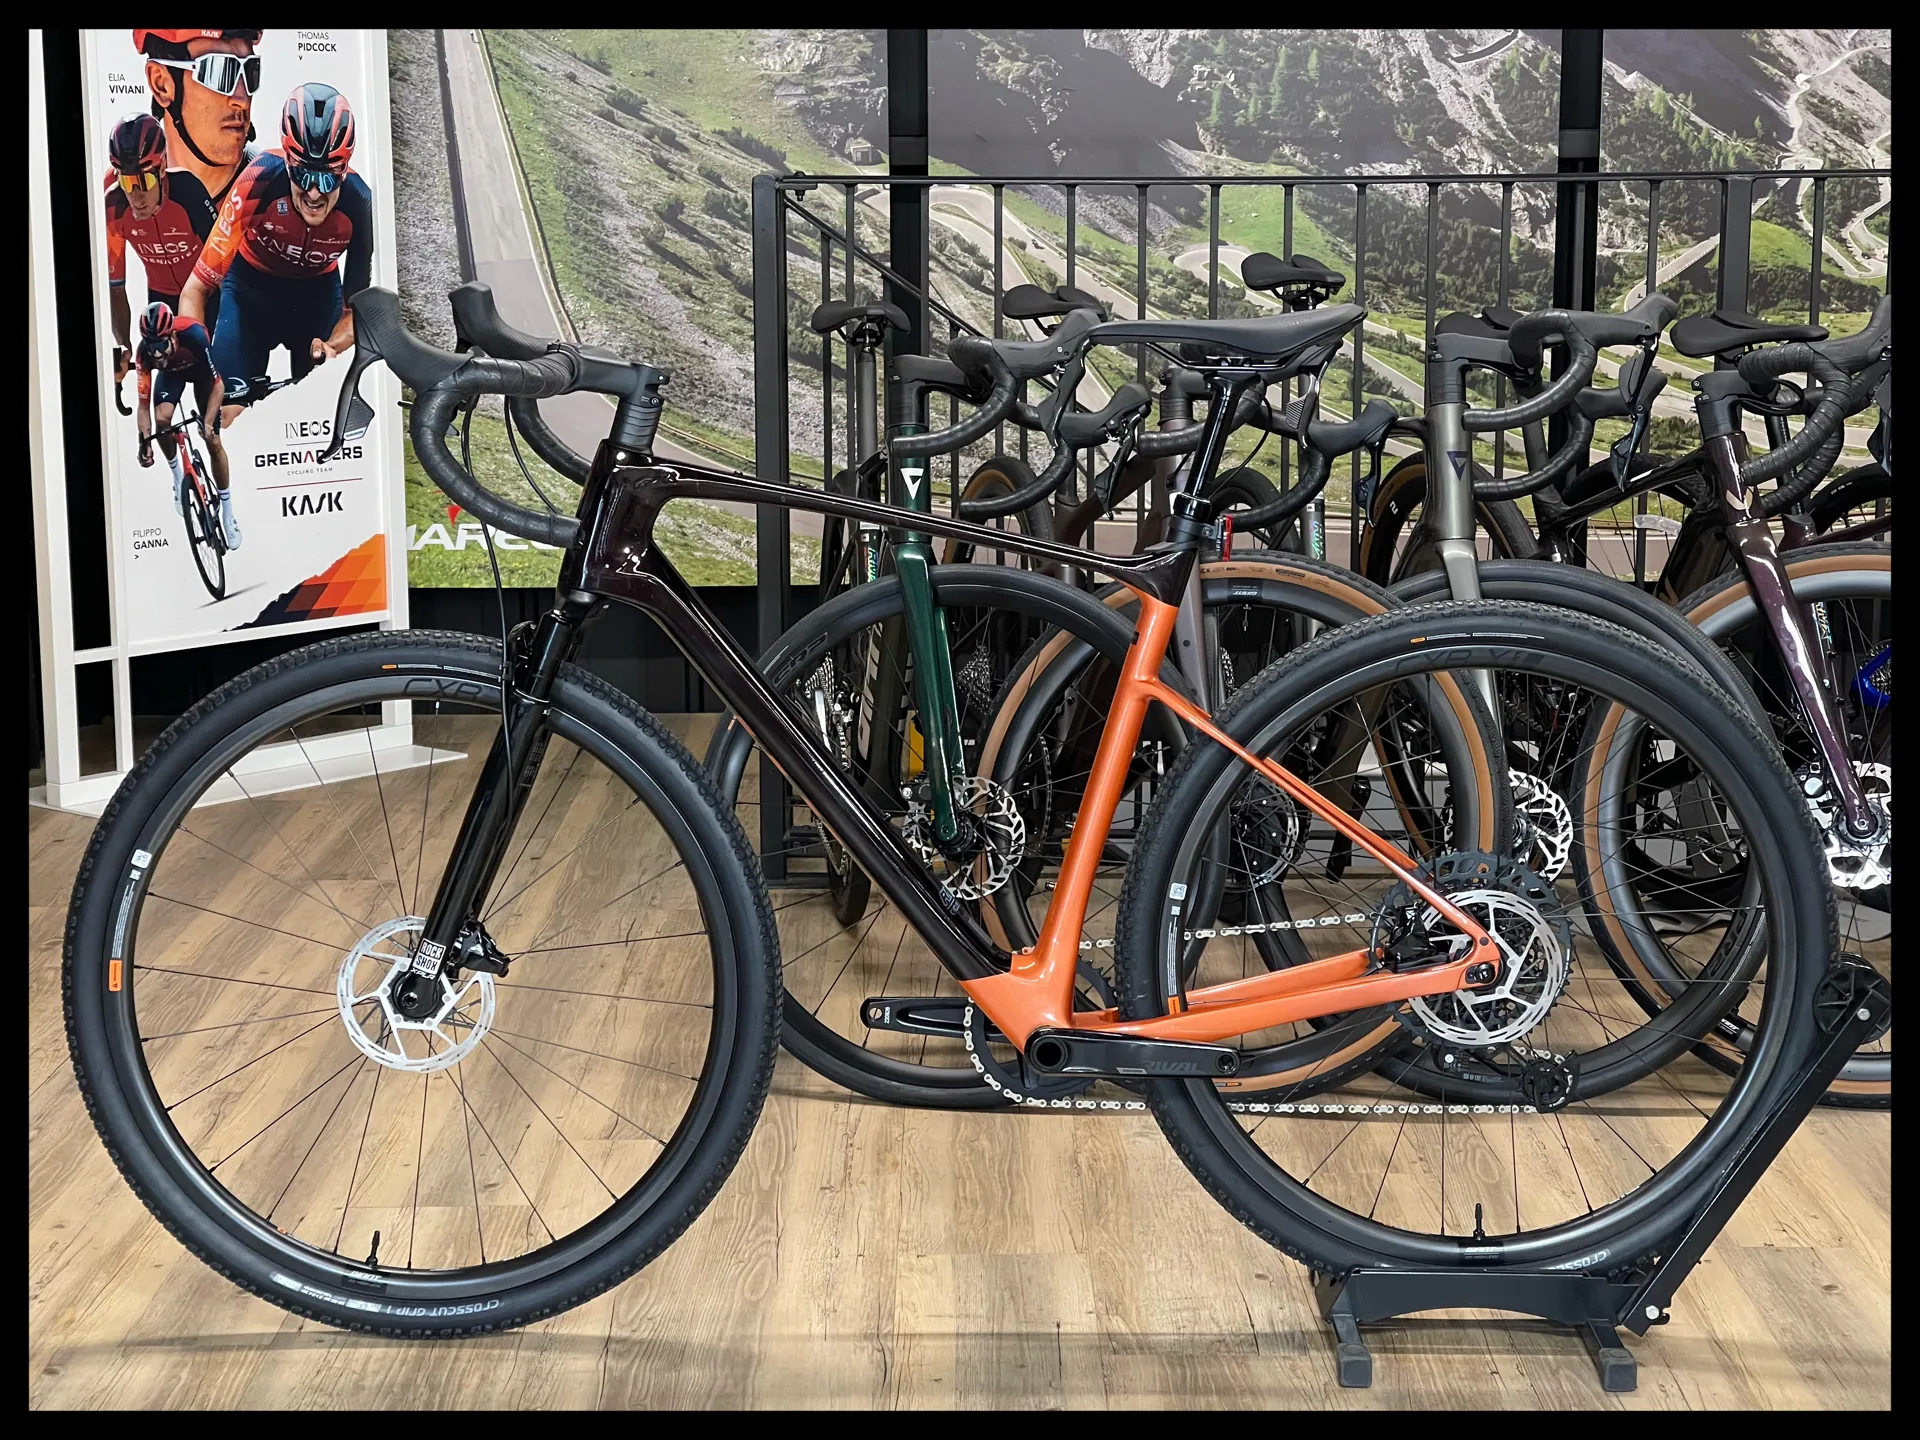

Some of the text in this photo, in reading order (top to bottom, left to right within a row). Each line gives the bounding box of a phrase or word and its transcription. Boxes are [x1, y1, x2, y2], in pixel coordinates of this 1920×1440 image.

[297, 31, 329, 40] THOMAS
[297, 43, 338, 52] PIDCOCK
[108, 73, 126, 81] ELIA
[108, 85, 145, 94] VIVIANI
[137, 241, 189, 254] INEOS
[285, 420, 331, 439] INEOS
[254, 446, 363, 468] GRENARS
[287, 468, 314, 476] CYCLING
[281, 491, 344, 517] KASK
[132, 528, 162, 538] FILIPPO
[133, 538, 169, 550] GANNA
[421, 941, 443, 959] ROCK
[416, 953, 438, 971] SHOX
[410, 968, 436, 980] XPLR
[1143, 1060, 1204, 1073] RIVAL
